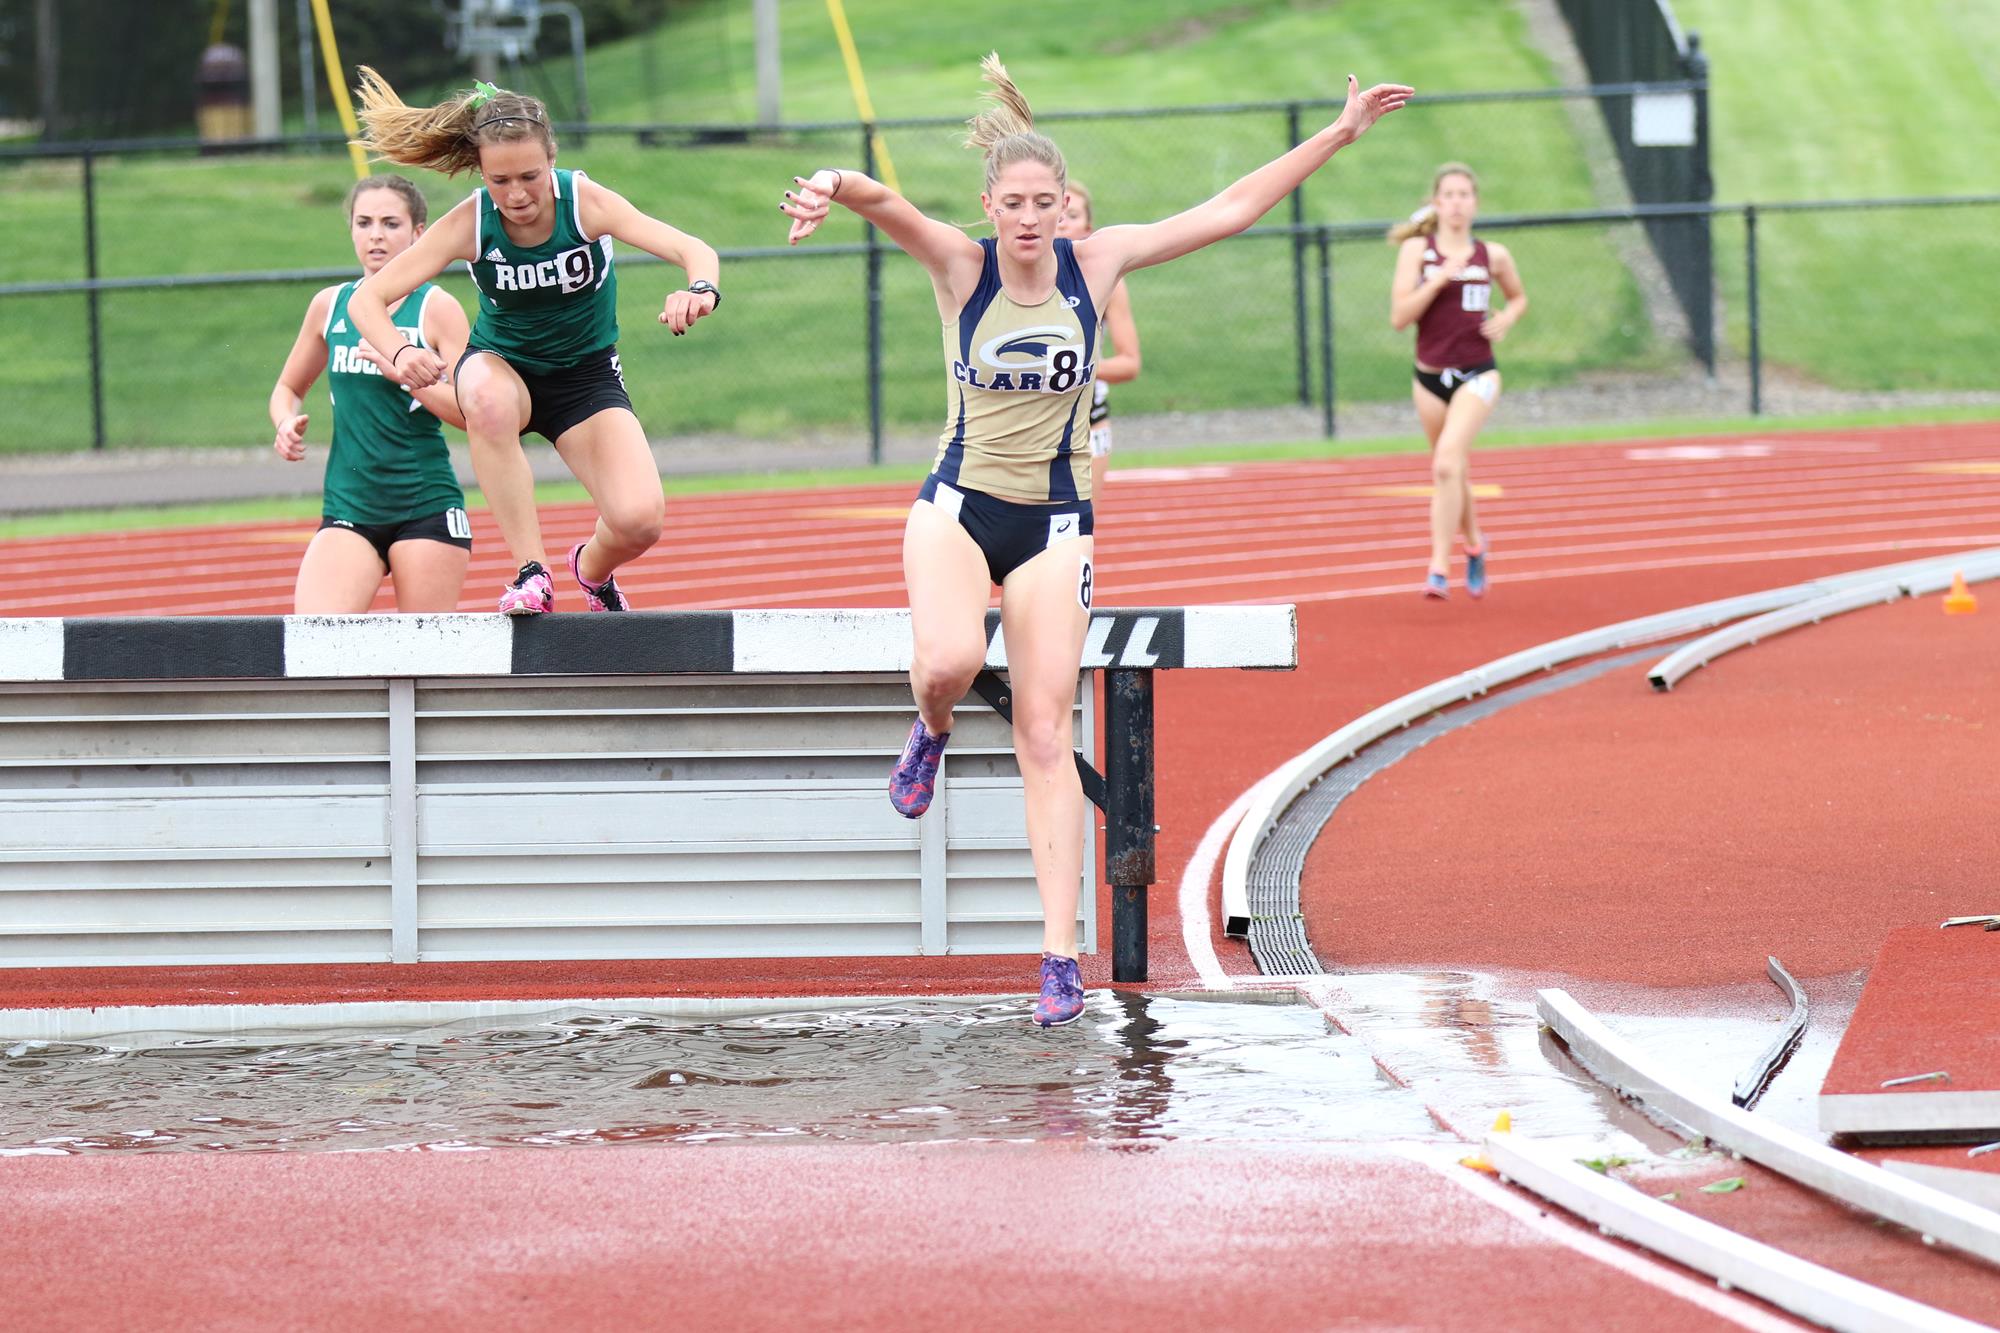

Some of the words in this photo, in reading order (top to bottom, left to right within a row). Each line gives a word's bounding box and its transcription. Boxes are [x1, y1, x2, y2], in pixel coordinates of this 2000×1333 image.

[565, 250, 590, 289] 9
[1049, 350, 1078, 392] 8
[1081, 563, 1091, 609] 8
